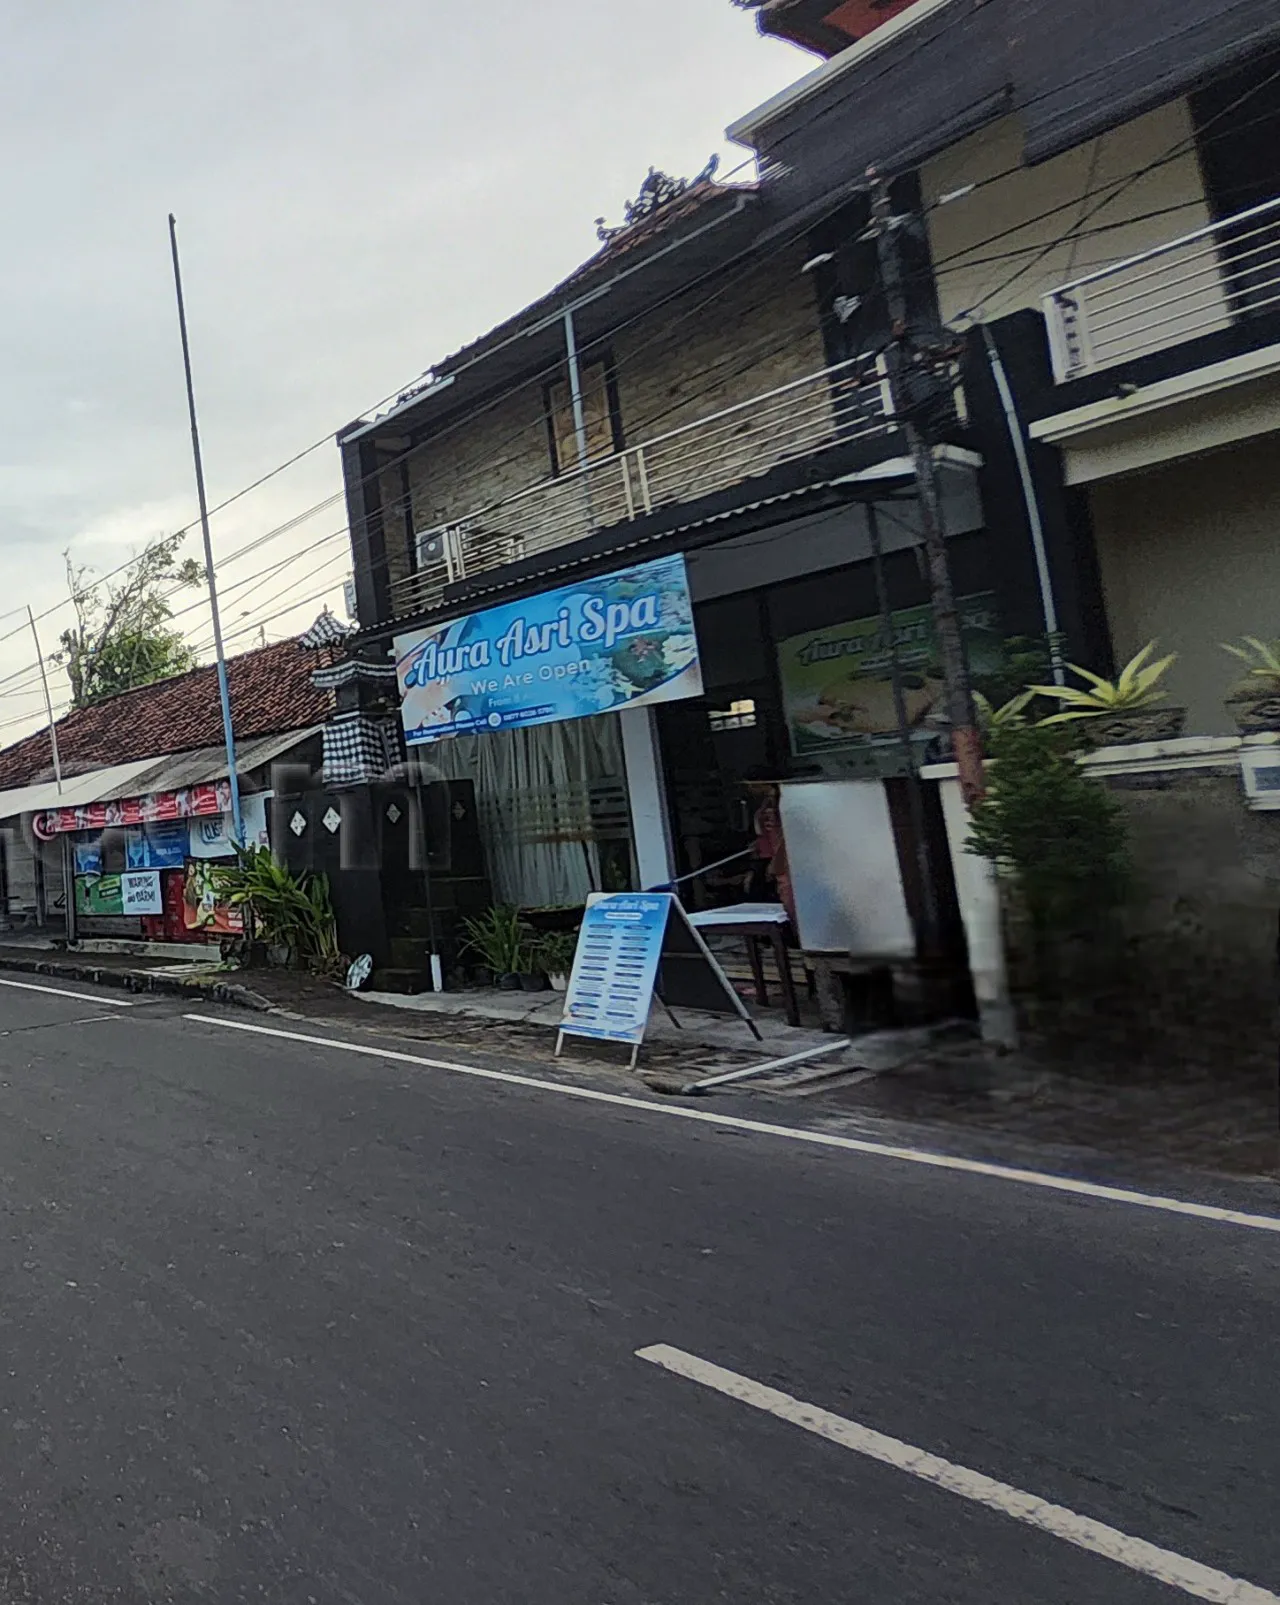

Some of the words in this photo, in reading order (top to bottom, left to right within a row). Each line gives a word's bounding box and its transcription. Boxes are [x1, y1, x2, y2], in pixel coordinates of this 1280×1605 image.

[408, 641, 491, 688] Aura
[496, 611, 572, 665] Asri
[580, 595, 658, 648] Spa
[470, 679, 498, 696] We
[503, 672, 534, 689] Are
[539, 659, 590, 681] Open
